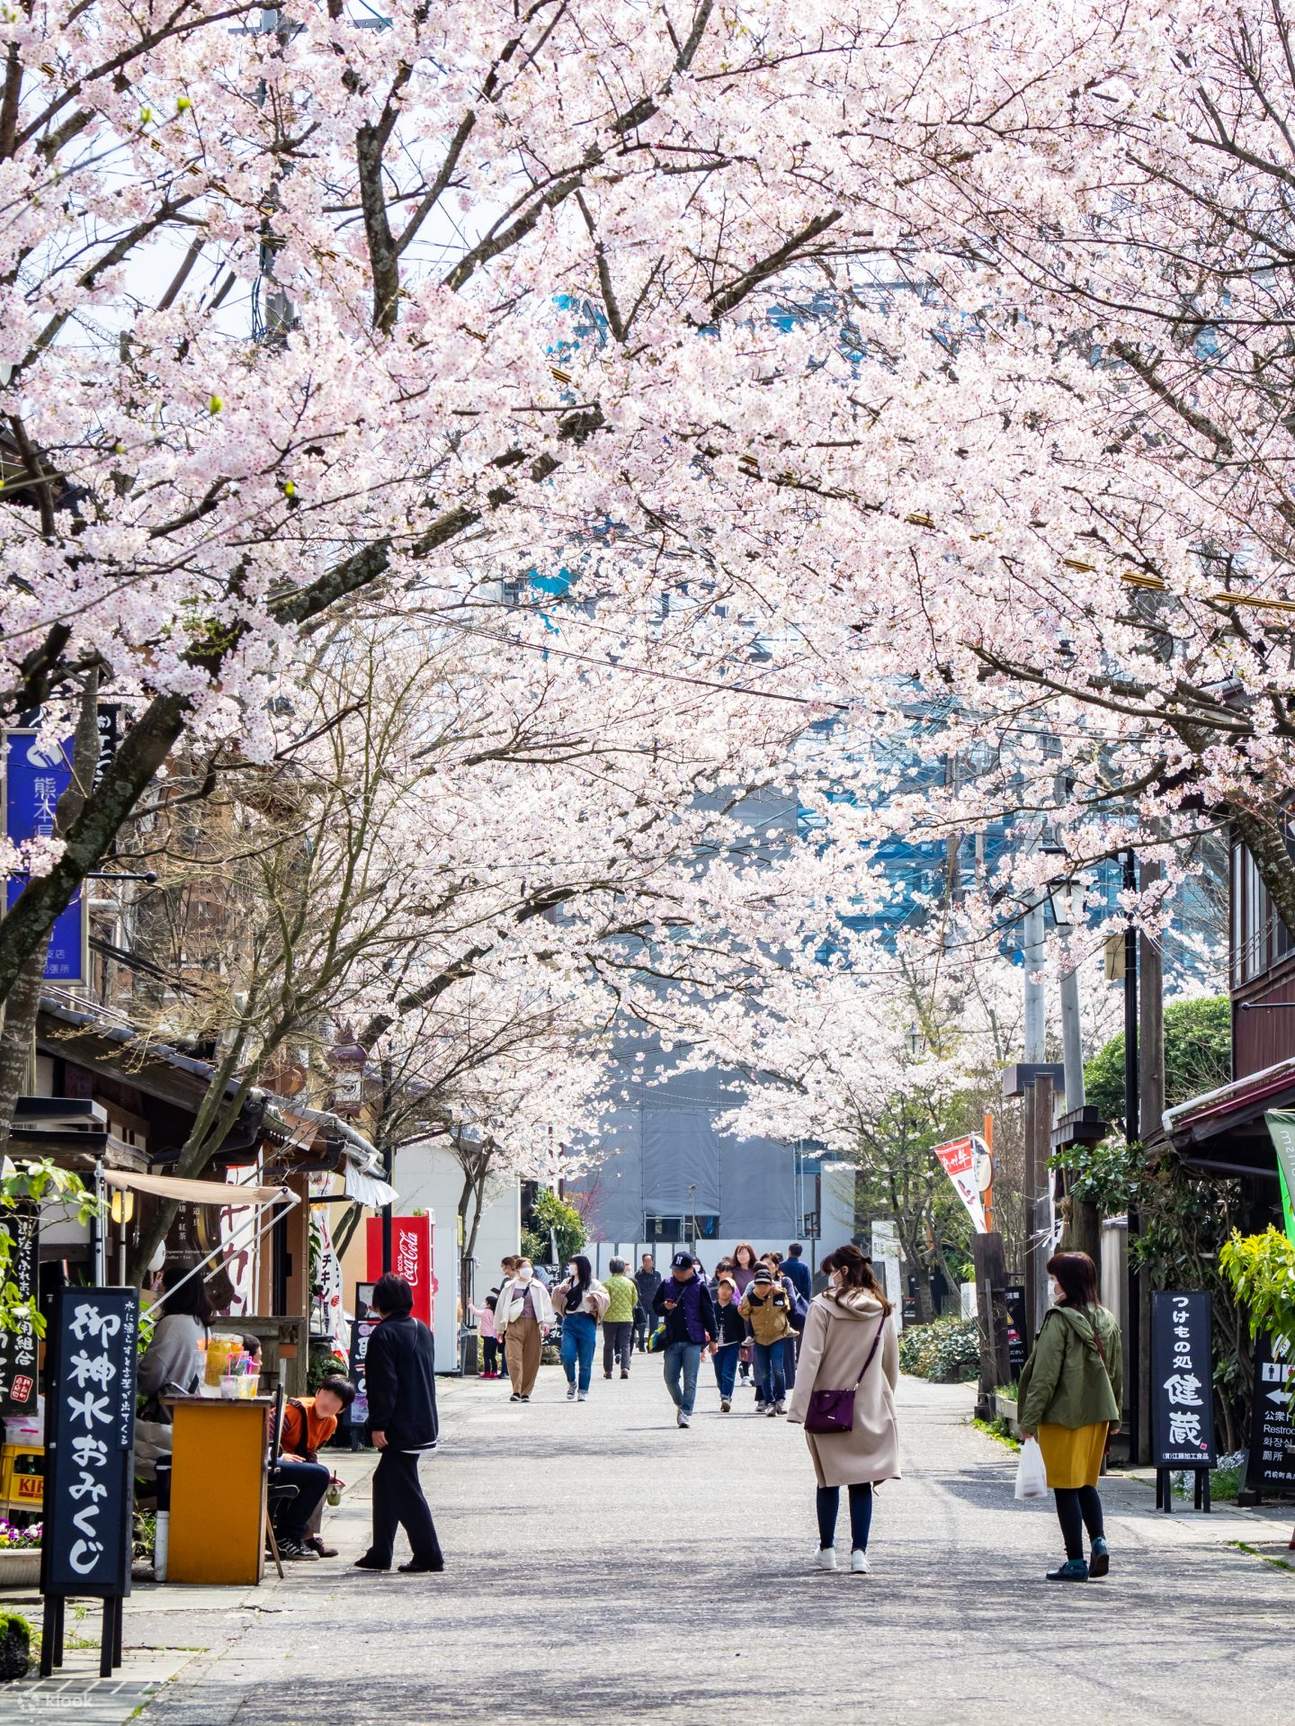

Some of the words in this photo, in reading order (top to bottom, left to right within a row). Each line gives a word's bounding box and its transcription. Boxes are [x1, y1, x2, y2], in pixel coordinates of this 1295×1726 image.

[1172, 1297, 1193, 1369] つけもの処
[69, 1304, 120, 1575] 御神水おみくじ
